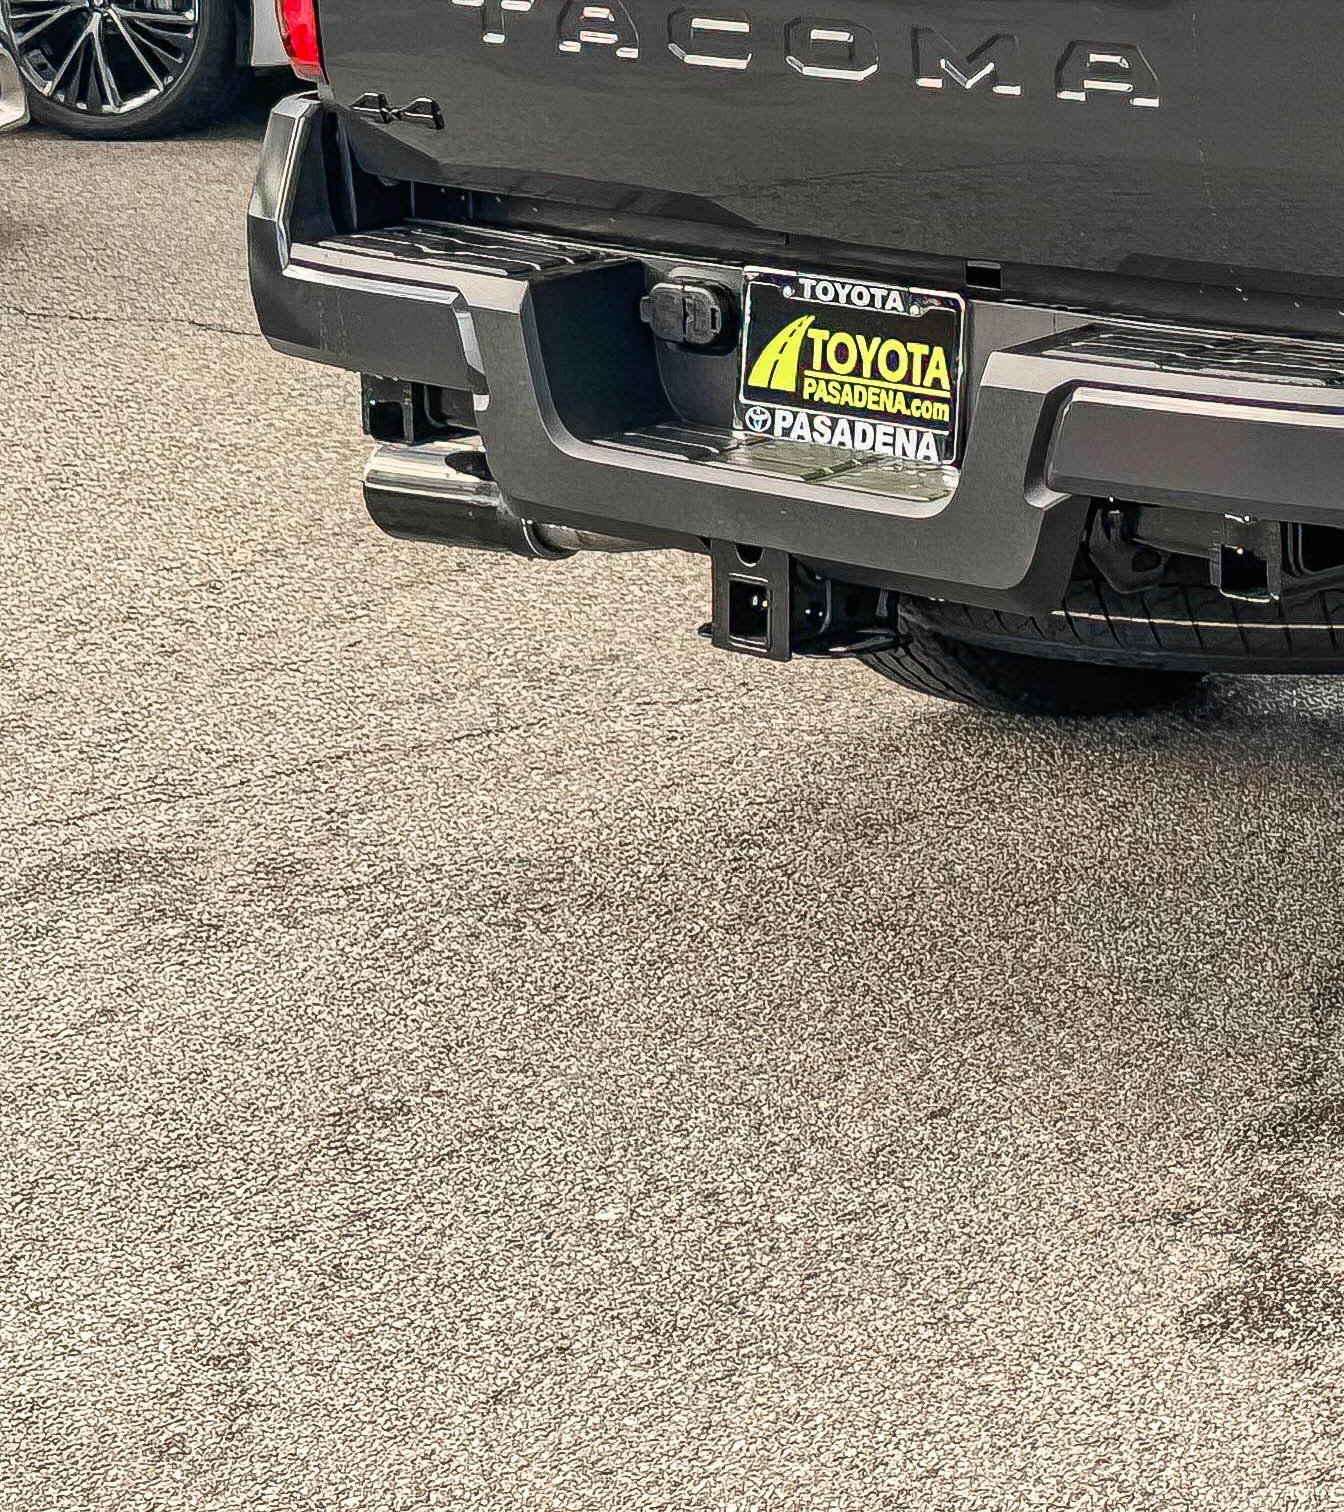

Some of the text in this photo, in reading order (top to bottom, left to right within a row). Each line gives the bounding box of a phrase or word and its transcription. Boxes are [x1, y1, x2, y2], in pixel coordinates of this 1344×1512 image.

[798, 278, 904, 313] TOYOTA
[807, 328, 951, 390] TOYOTA
[803, 377, 950, 422] PASADENA.com
[773, 409, 940, 463] PASADENA
